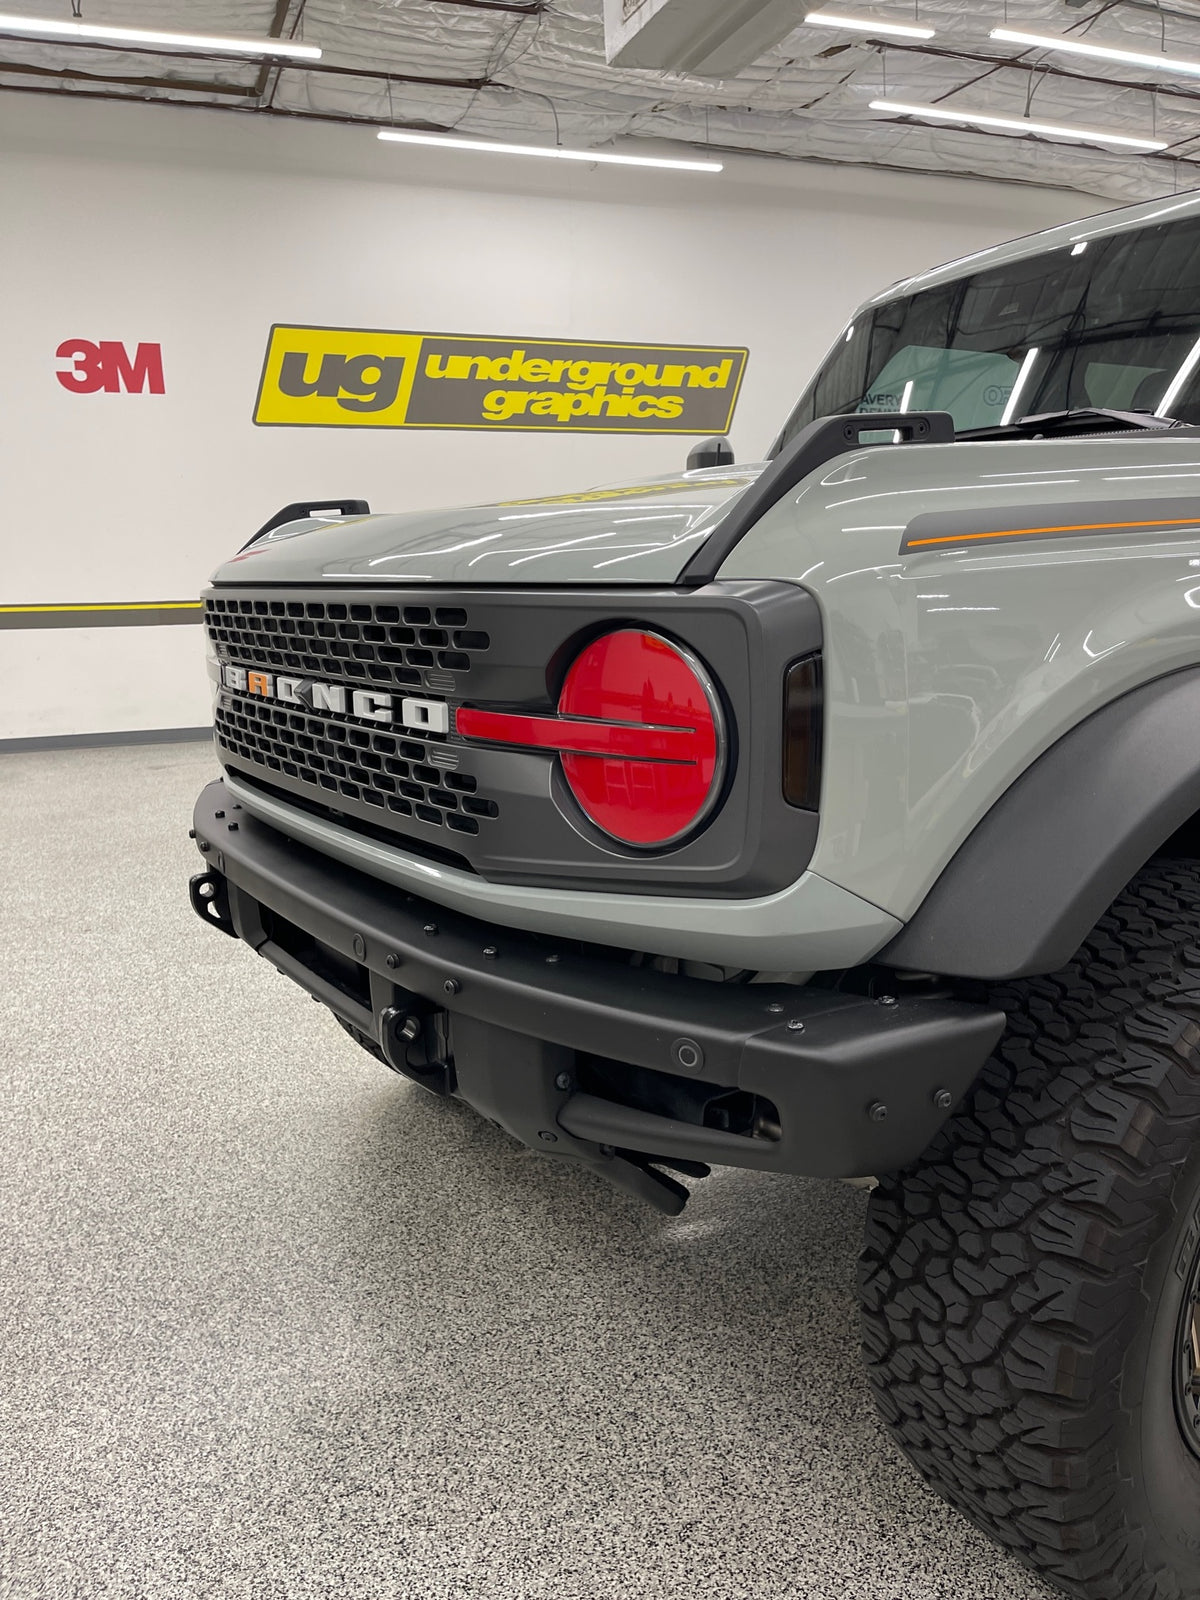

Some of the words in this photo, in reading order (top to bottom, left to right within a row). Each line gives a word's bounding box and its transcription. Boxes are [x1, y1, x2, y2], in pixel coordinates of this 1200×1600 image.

[56, 339, 165, 394] 3M
[278, 352, 405, 413] ug
[425, 350, 733, 391] underground
[482, 386, 685, 422] graphics
[225, 666, 449, 733] BRONCO
